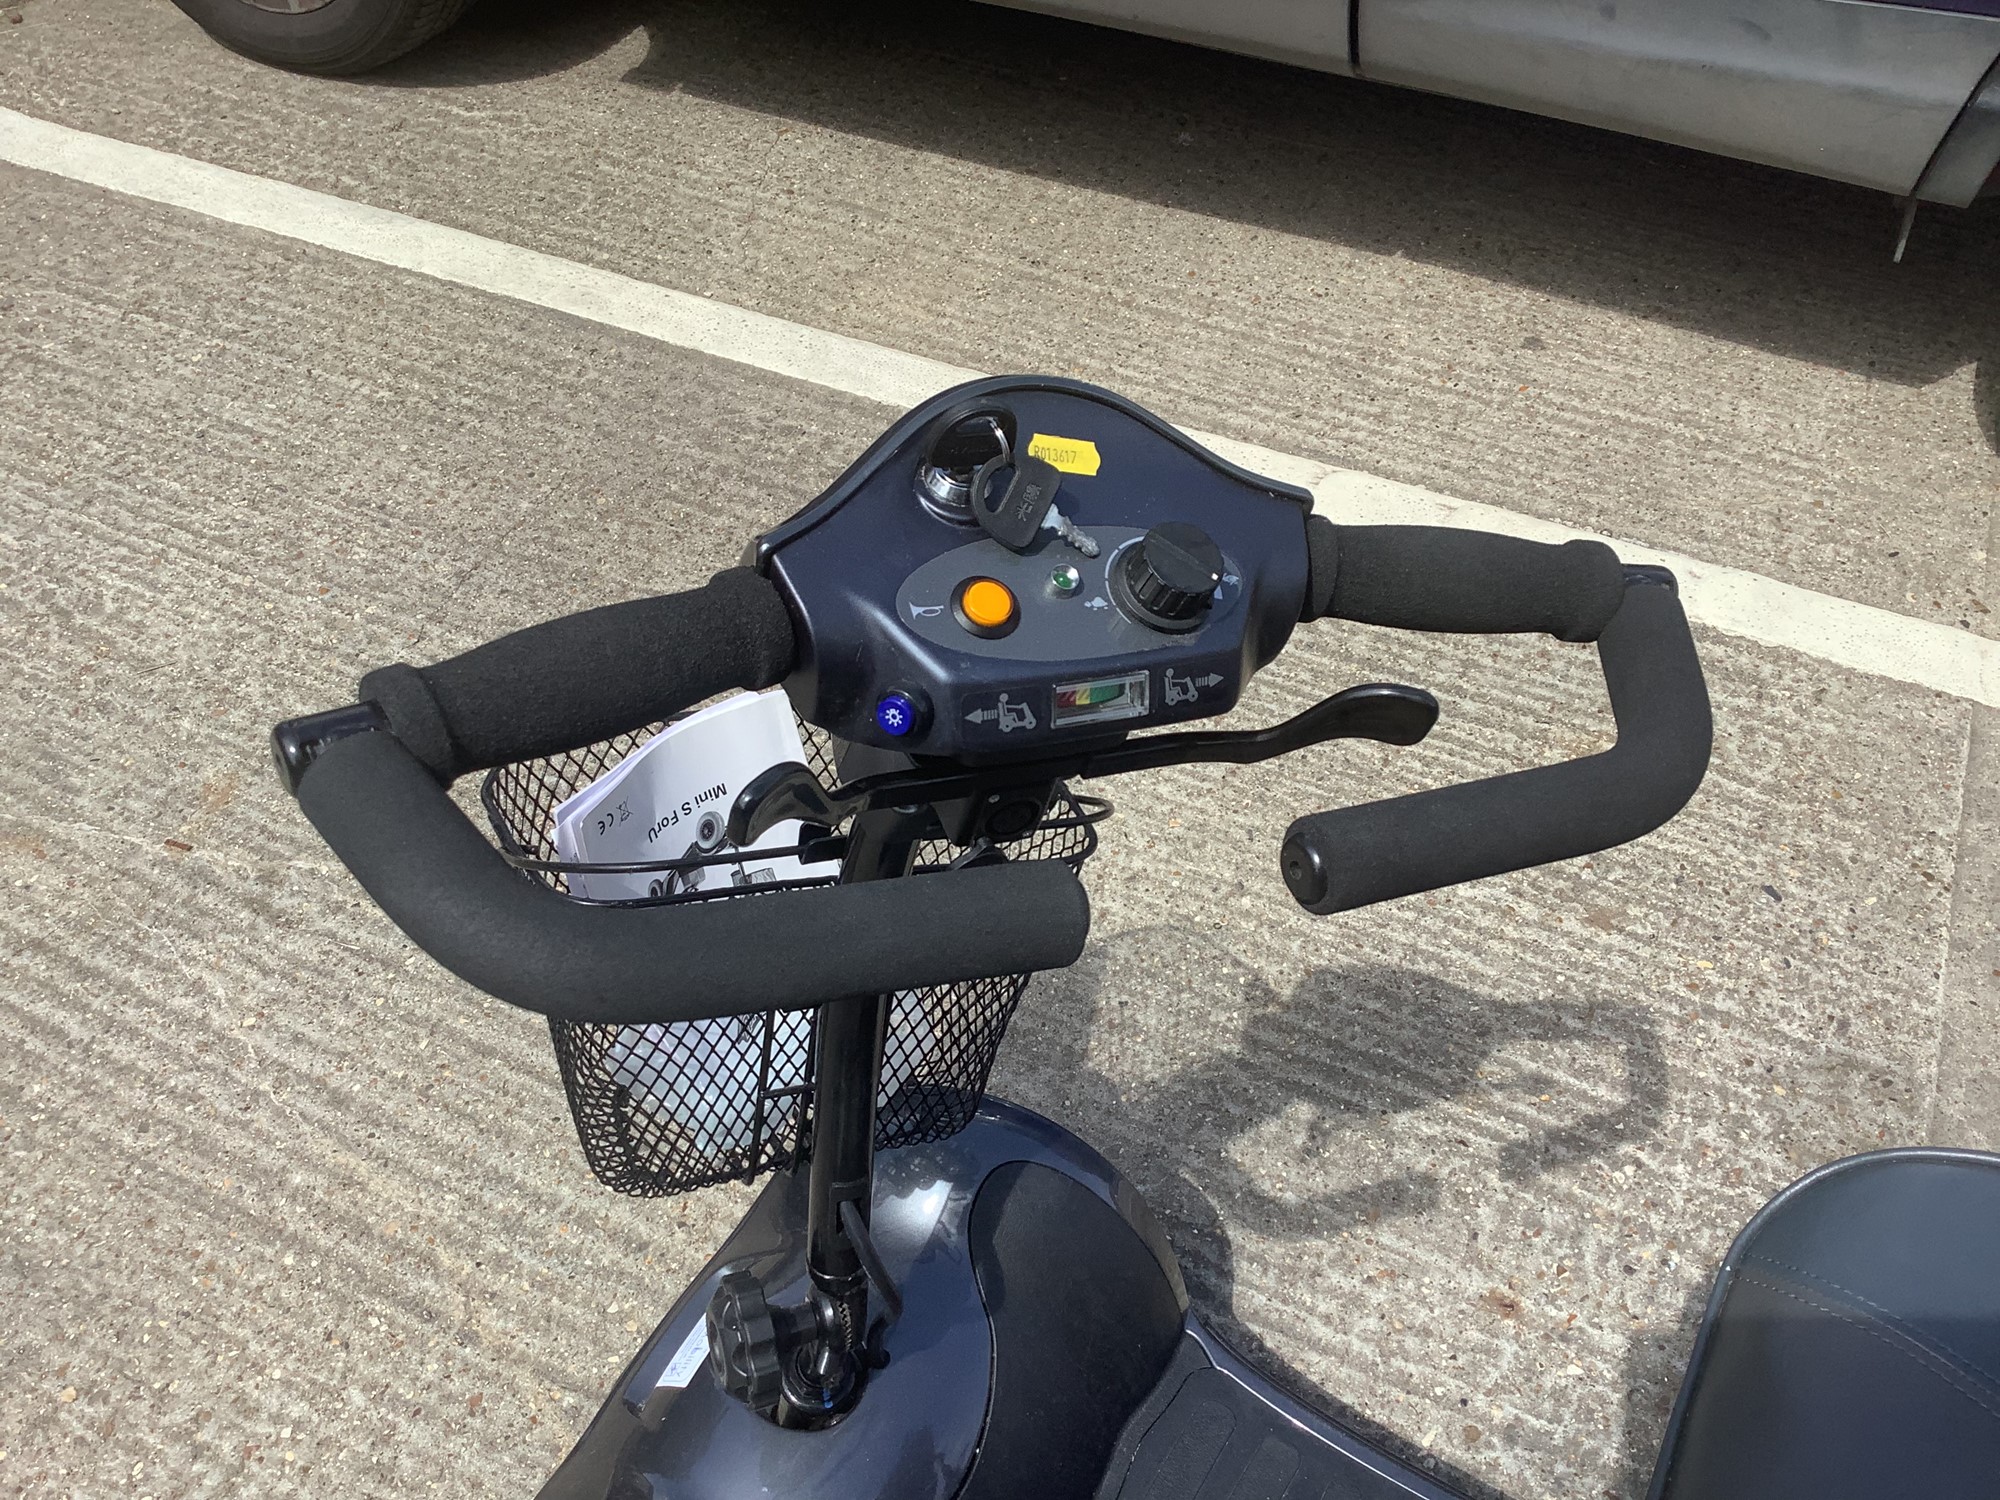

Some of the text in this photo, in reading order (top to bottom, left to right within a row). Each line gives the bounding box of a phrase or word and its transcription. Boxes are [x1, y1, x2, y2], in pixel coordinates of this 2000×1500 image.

[1033, 445, 1077, 464] R013617
[648, 783, 727, 843] Mini S ForU
